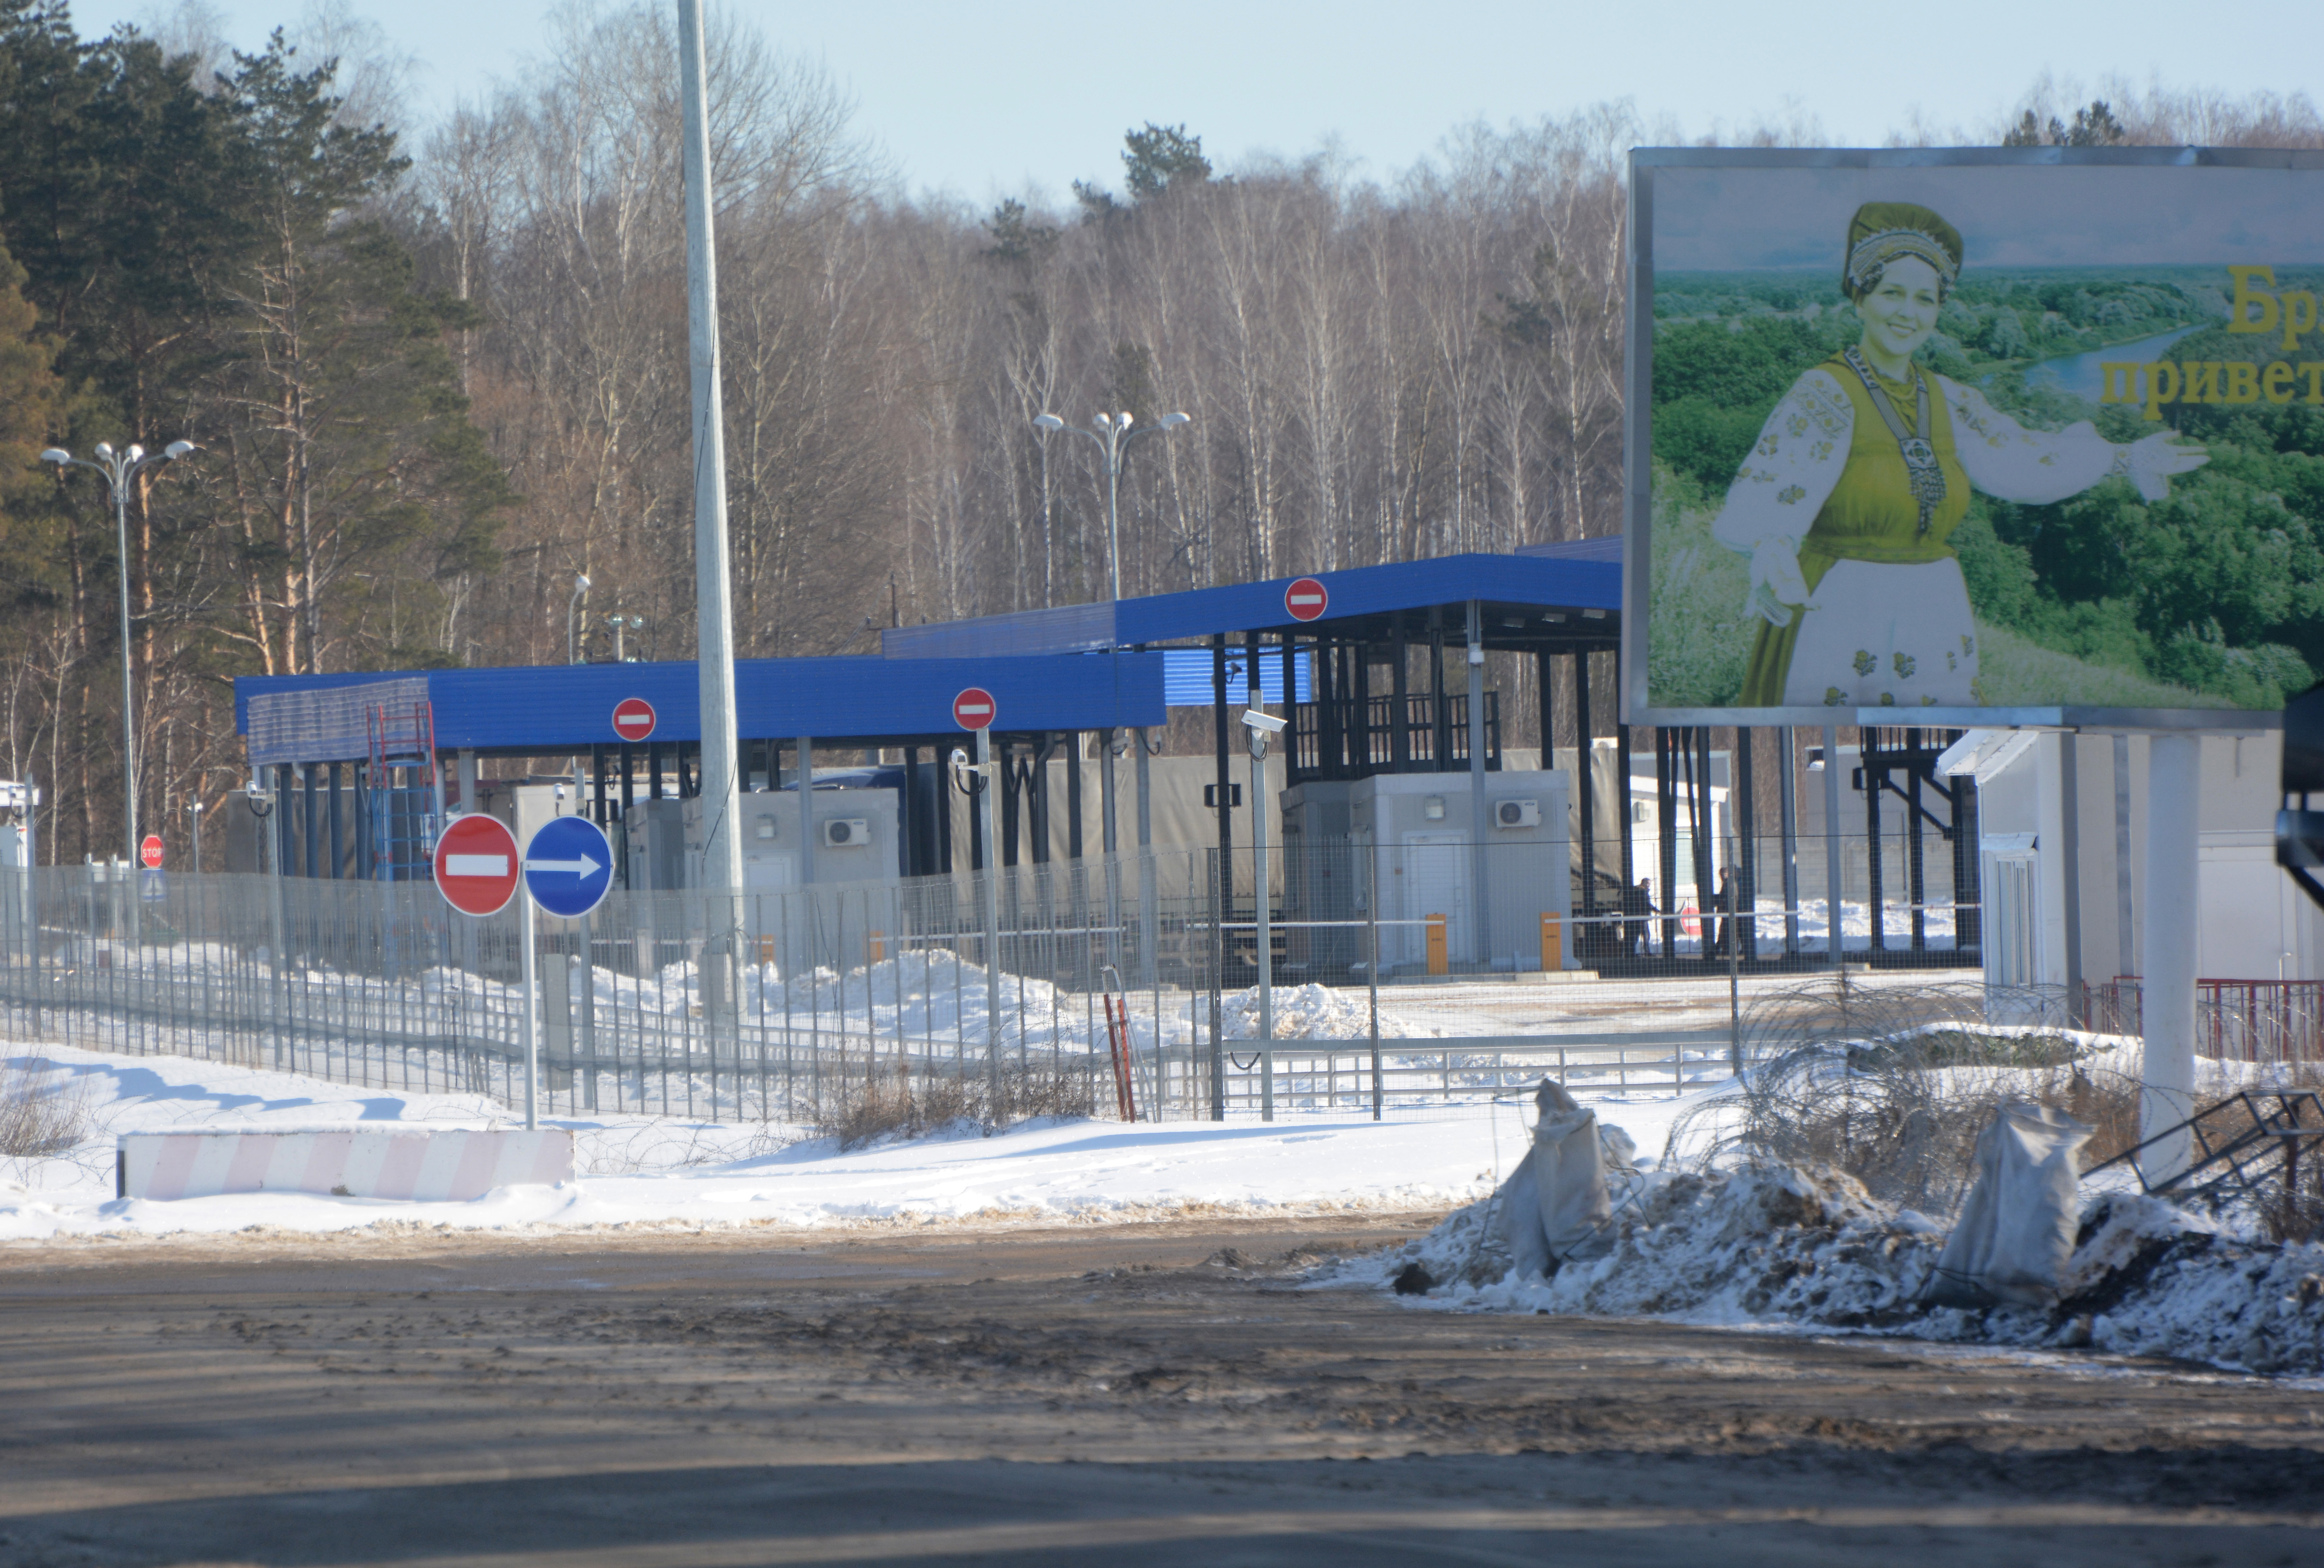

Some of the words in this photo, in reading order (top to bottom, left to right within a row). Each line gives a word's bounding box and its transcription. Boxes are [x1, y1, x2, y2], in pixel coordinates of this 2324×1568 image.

[2227, 265, 2324, 351] Бр
[2100, 360, 2324, 421] привет
[143, 847, 163, 858] STOP
